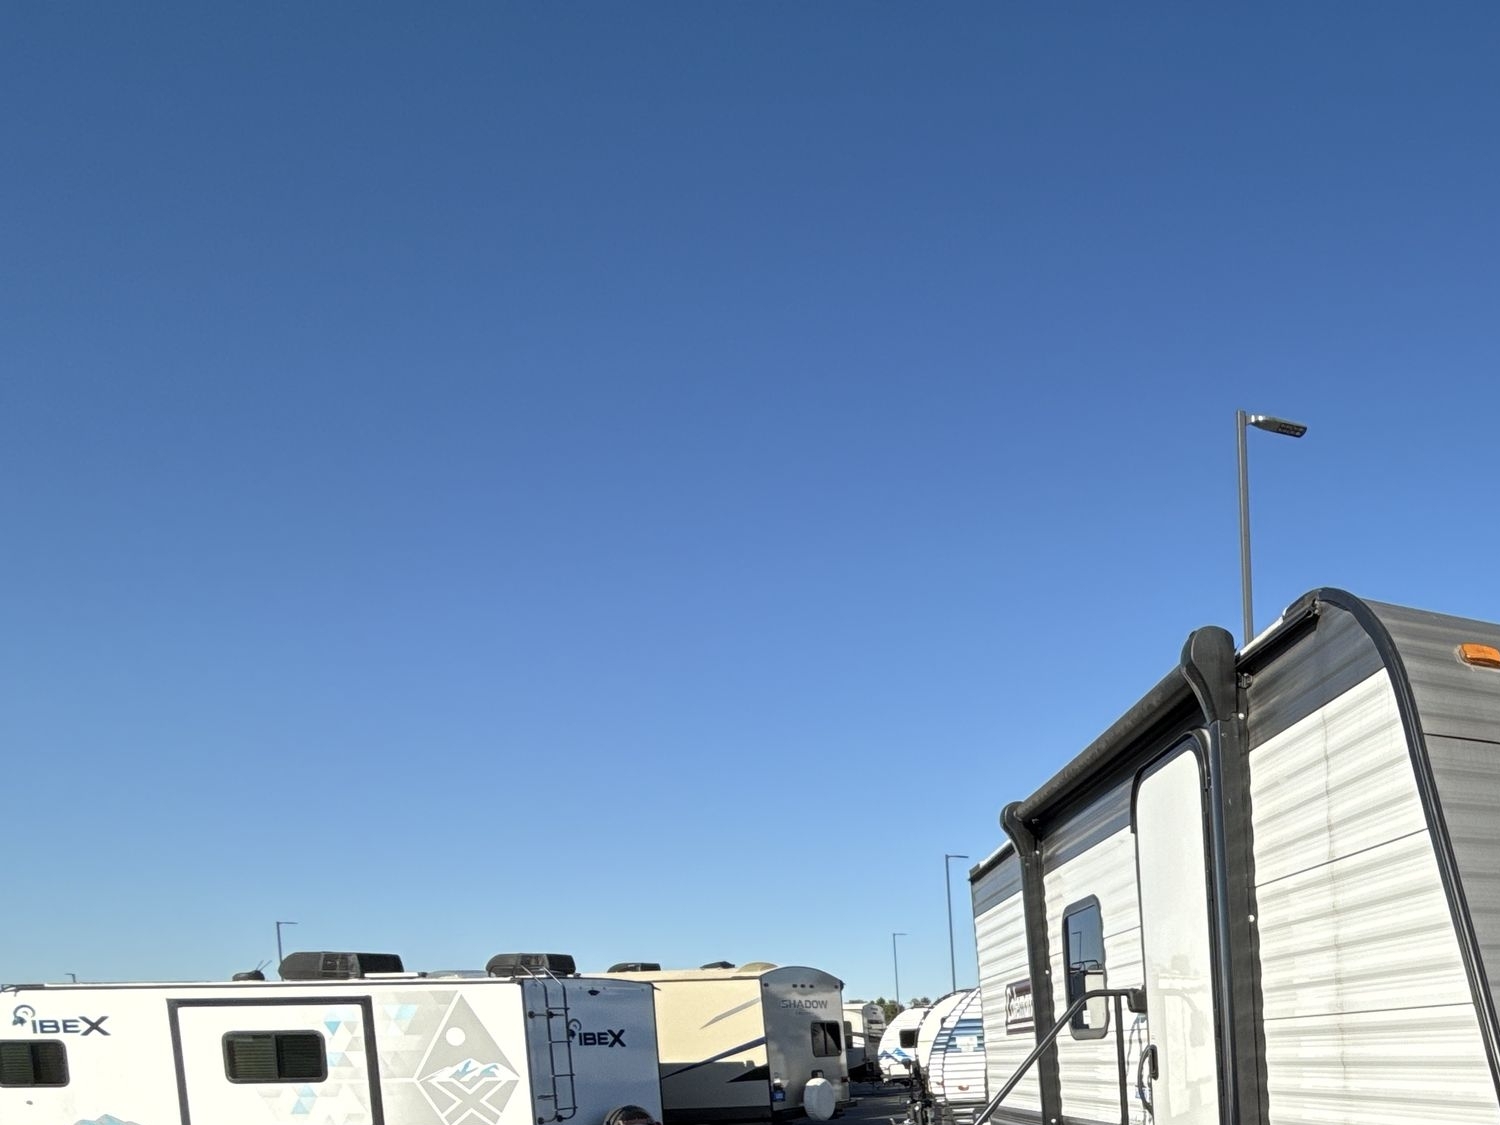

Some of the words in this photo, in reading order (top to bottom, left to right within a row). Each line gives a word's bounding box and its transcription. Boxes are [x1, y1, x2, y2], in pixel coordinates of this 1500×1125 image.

[781, 999, 828, 1009] SHADOW
[31, 1016, 111, 1036] IBEX
[579, 1029, 626, 1048] IBEX
